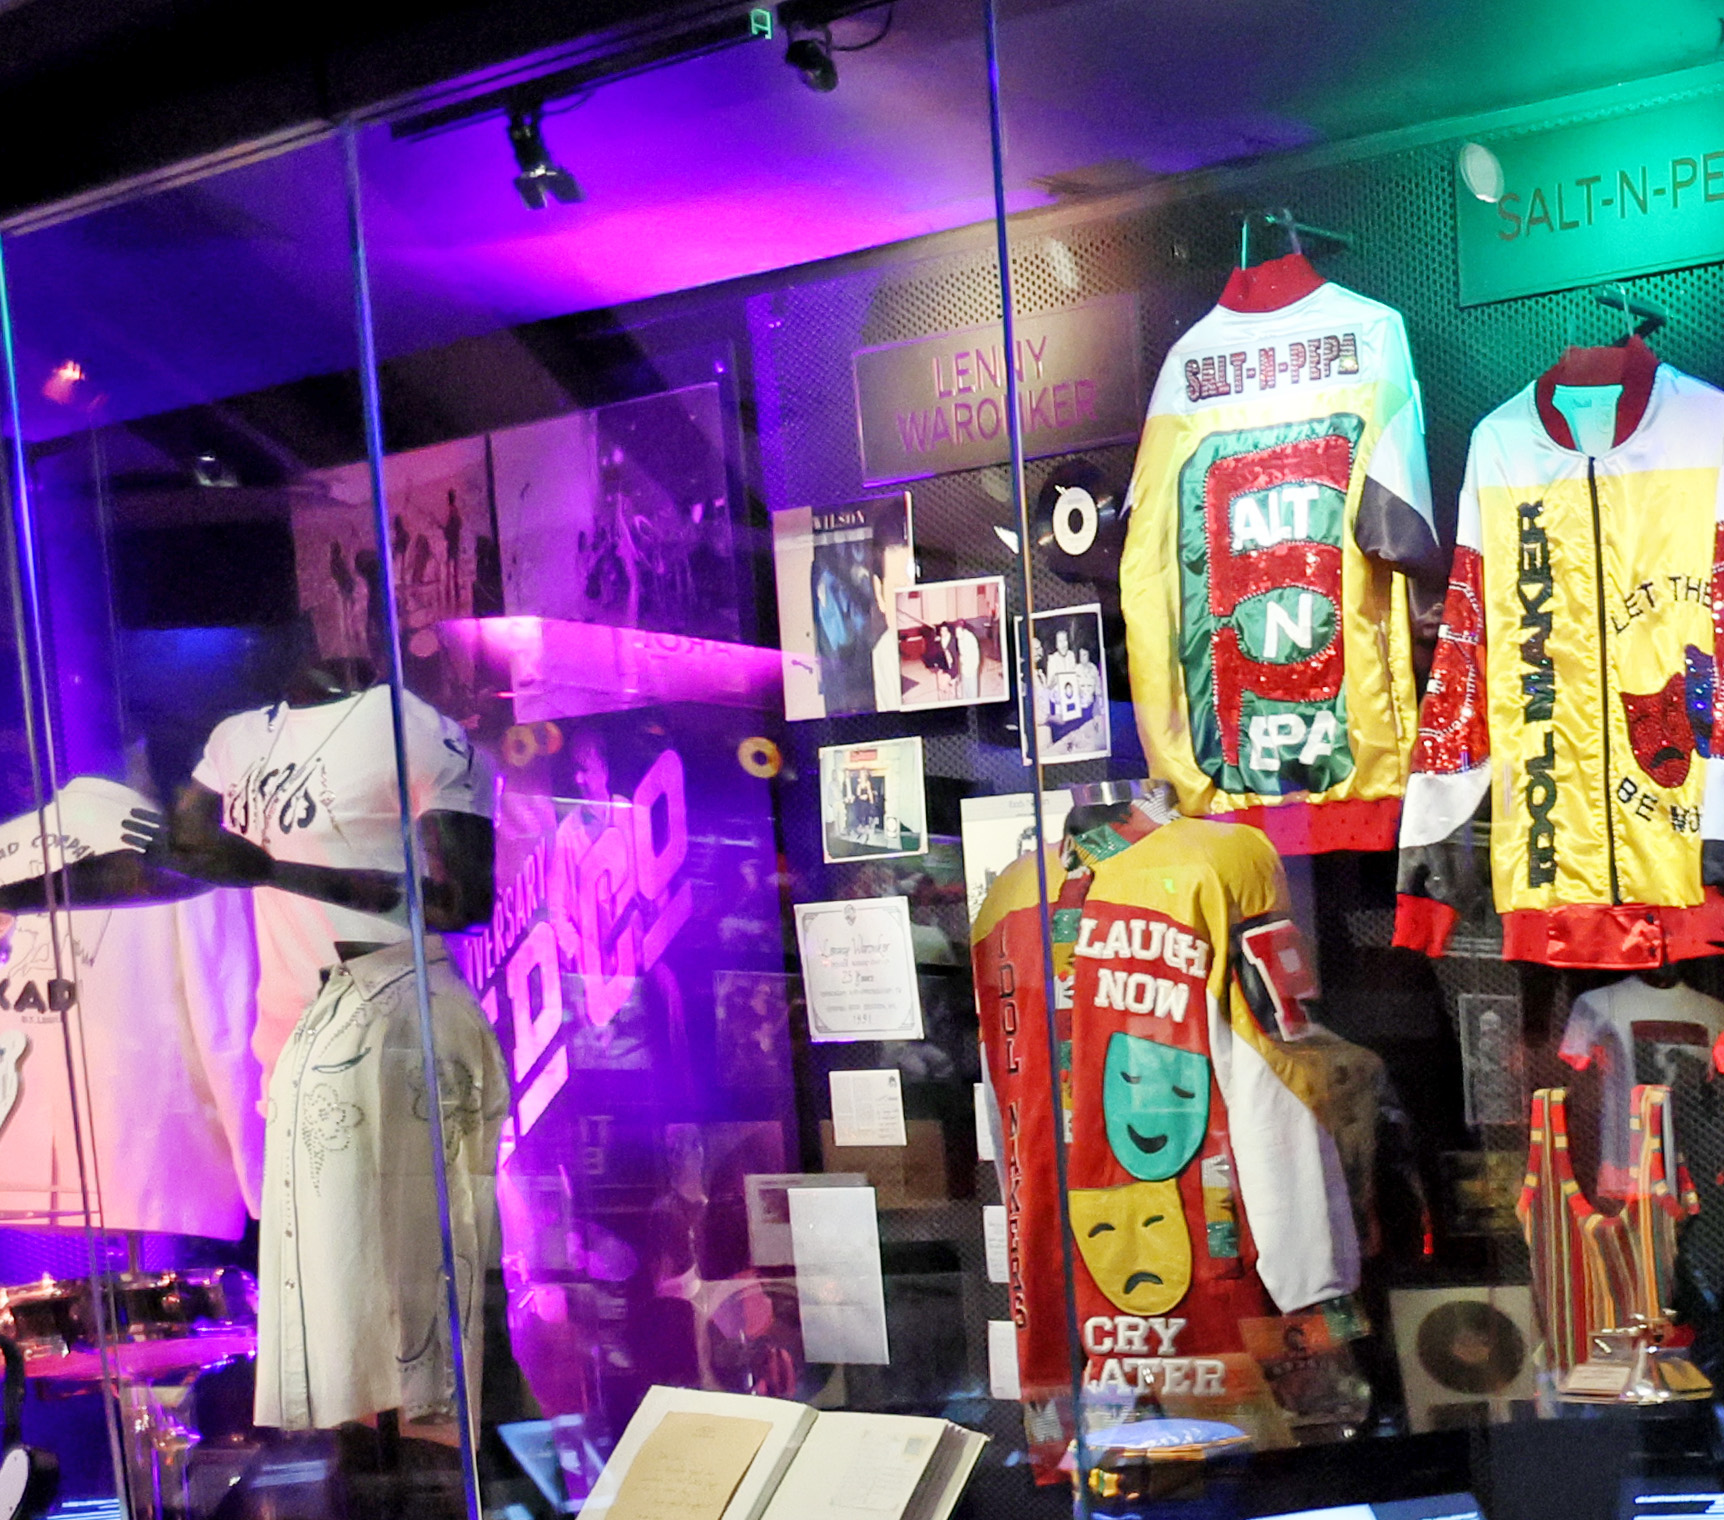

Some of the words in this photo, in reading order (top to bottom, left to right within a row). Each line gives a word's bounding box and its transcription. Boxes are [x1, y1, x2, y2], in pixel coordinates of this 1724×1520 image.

[932, 336, 1047, 399] LENNY
[1184, 333, 1359, 402] SALT-N-PEPA
[1232, 486, 1320, 550] ALT
[1262, 593, 1313, 659] N
[1518, 500, 1556, 723] MAKER
[1611, 582, 1654, 633] LET
[1525, 731, 1557, 888] IDOL
[1617, 777, 1657, 821] BE
[1075, 918, 1209, 978] LAUGH
[1095, 969, 1188, 1023] NOW
[1083, 1317, 1186, 1356] CRY
